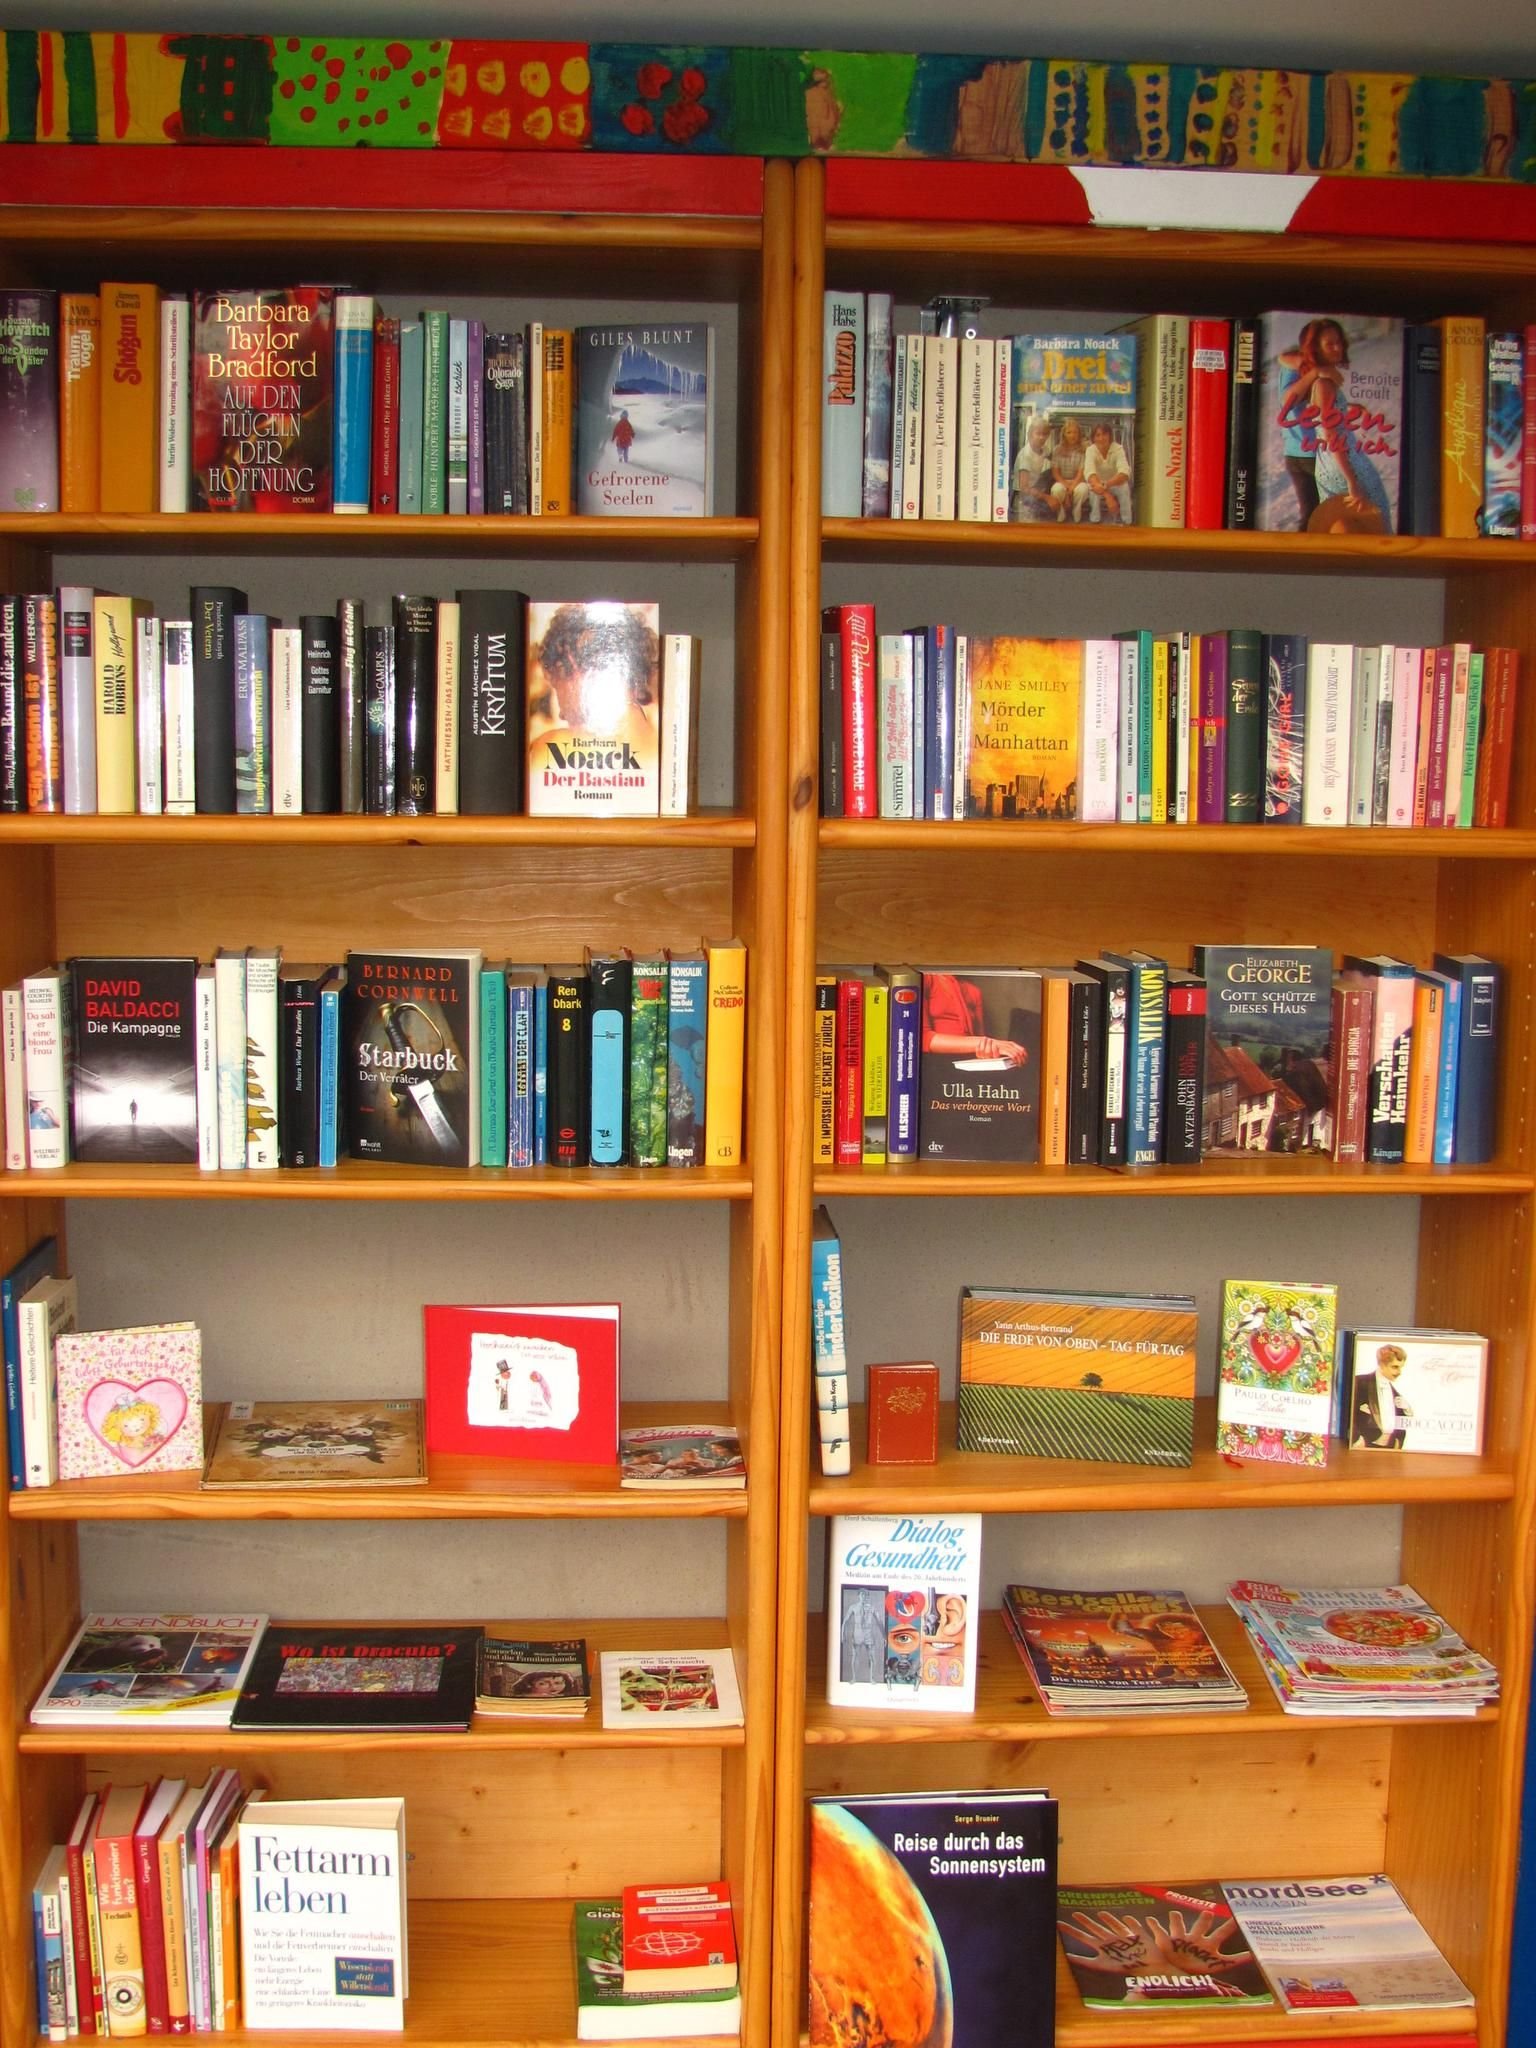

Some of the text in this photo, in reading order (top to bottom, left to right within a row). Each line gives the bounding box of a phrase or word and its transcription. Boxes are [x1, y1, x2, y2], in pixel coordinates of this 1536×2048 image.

[216, 298, 310, 322] Barbara
[833, 304, 856, 317] Hans
[833, 317, 856, 327] Habe
[227, 327, 298, 359] Taylor
[590, 331, 693, 346] GILES BLUNT
[1033, 338, 1119, 350] Barbara Noack
[78, 330, 94, 368] vogel
[1237, 331, 1254, 384] Puma
[68, 335, 80, 382] Traum
[208, 354, 317, 378] Bradford
[1042, 351, 1108, 380] Drei
[454, 361, 463, 394] tschick
[487, 366, 522, 380] Colorado
[828, 331, 857, 406] Palazzo
[495, 375, 514, 390] Saga
[169, 382, 177, 416] Vormittag
[223, 386, 301, 408] AUF DEN
[1350, 386, 1390, 400] Groult
[222, 411, 301, 438] FLÜGELN
[1278, 401, 1396, 434] Leben
[168, 418, 176, 442] Walser
[239, 441, 283, 465] DER
[1301, 432, 1398, 457] will ich
[167, 444, 176, 468] Martin
[208, 468, 315, 492] HOFFNUNG
[588, 471, 670, 487] Gefrorene
[1165, 428, 1183, 521] Barbara Noack
[603, 490, 653, 506] Seelen
[203, 600, 214, 660] Der Veteran
[345, 603, 355, 668] Flug in Gefahr
[238, 620, 247, 699] ERIC MALPASS
[307, 650, 332, 660] Heinrich
[311, 666, 329, 675] Gottes
[311, 675, 329, 684] zweite
[375, 651, 385, 704] Der CAMPUS
[103, 664, 115, 715] HAROLD
[116, 665, 126, 715] ROBBINS
[308, 686, 332, 695] Garnitur
[480, 633, 507, 736] KRYPTUM
[977, 680, 1069, 692] JANE SMILEY
[980, 700, 1046, 718] Mörder
[996, 719, 1009, 732] in
[1464, 714, 1477, 751] Handke
[444, 709, 452, 773] MATTHIESSEN
[572, 738, 617, 748] Barbara
[973, 732, 1069, 751] Manhattan
[1276, 693, 1292, 791] GONE GIRL
[545, 742, 642, 770] Noack
[1464, 752, 1475, 777] Peter
[543, 772, 645, 787] Der Bastian
[893, 765, 904, 811] Simmel
[283, 794, 292, 808] dtv
[574, 790, 613, 800] Roman
[1418, 784, 1426, 808] KRIMI
[633, 966, 668, 976] KONSALIK
[671, 966, 703, 977] KONSALIK
[1246, 958, 1298, 968] ELIZABETH
[364, 964, 452, 982] BERNARD
[1226, 963, 1312, 984] GEORGE
[85, 980, 140, 997] DAVID
[358, 984, 459, 1002] CORNWELL
[557, 985, 577, 997] Ren
[1220, 990, 1316, 1002] GOTT SCHÜTZE
[86, 1002, 180, 1018] BALDACCI
[553, 998, 582, 1010] Dhark
[713, 997, 743, 1009] CREDO
[1138, 969, 1164, 1044] KONSALIK
[1229, 1002, 1307, 1014] DIESES HAUS
[26, 1012, 56, 1020] Da sah
[562, 1018, 571, 1031] 8
[33, 1030, 51, 1038] eine
[87, 1021, 181, 1037] Die Kampagne
[516, 1013, 527, 1056] DER CLAN
[28, 1037, 56, 1046] blonde
[33, 1047, 53, 1056] Frau
[359, 1043, 458, 1072] Starbuck
[1178, 1055, 1187, 1076] DAS
[359, 1071, 419, 1085] Der Verräter
[821, 1015, 833, 1155] DR. IMPOSSIBLE SCHLÄGT ZURÜCK
[1391, 1033, 1410, 1123] Heimkehr
[942, 1083, 1020, 1100] Ulla Hahn
[1177, 1079, 1187, 1106] JOHN
[931, 1100, 1032, 1114] Das verborgene Wort
[1184, 1079, 1195, 1147] KATZENBACH
[1418, 1075, 1430, 1151] JANET EVANOVICH
[969, 1115, 992, 1123] Roman
[668, 1146, 694, 1158] Lingen
[928, 1142, 944, 1152] dtv
[816, 1299, 825, 1355] große farbige
[994, 1321, 1073, 1334] Yann Arthus-Bertrand
[27, 1308, 37, 1385] Heitere Geschichten
[980, 1332, 1184, 1357] DIE ERDE VON OBEN TAG FÜR TAG
[1235, 1387, 1312, 1406] PAULO COELHO
[1400, 1416, 1474, 1431] BOCCACCIO
[889, 1518, 965, 1549] Dialog
[845, 1543, 969, 1572] Gesundheit
[845, 1571, 871, 1579] Medizin
[925, 1574, 966, 1583] Jahrhunderts
[1020, 1589, 1168, 1605] Bestseller
[1081, 1599, 1184, 1613] Games
[88, 1617, 259, 1628] JUGENDBUCH
[280, 1644, 457, 1658] Wo ist Dracula?
[46, 1699, 81, 1707] 1990
[955, 1814, 999, 1823] Serge Brunier
[894, 1832, 1024, 1852] Reise durch das
[251, 1835, 394, 1877] Fettarm
[111, 1842, 124, 1904] funktioniert
[143, 1859, 151, 1883] Gregor
[929, 1856, 1046, 1878] Sonnensystem
[100, 1886, 111, 1904] Wie
[127, 1879, 136, 1904] das?
[253, 1876, 350, 1914] leben
[1057, 1890, 1142, 1899] GREENPEACE
[1165, 1890, 1217, 1909] PROTESTE
[1224, 1882, 1369, 1900] nordsee
[104, 1911, 132, 1920] Technik
[1125, 1974, 1214, 1988] ENDLICH!
